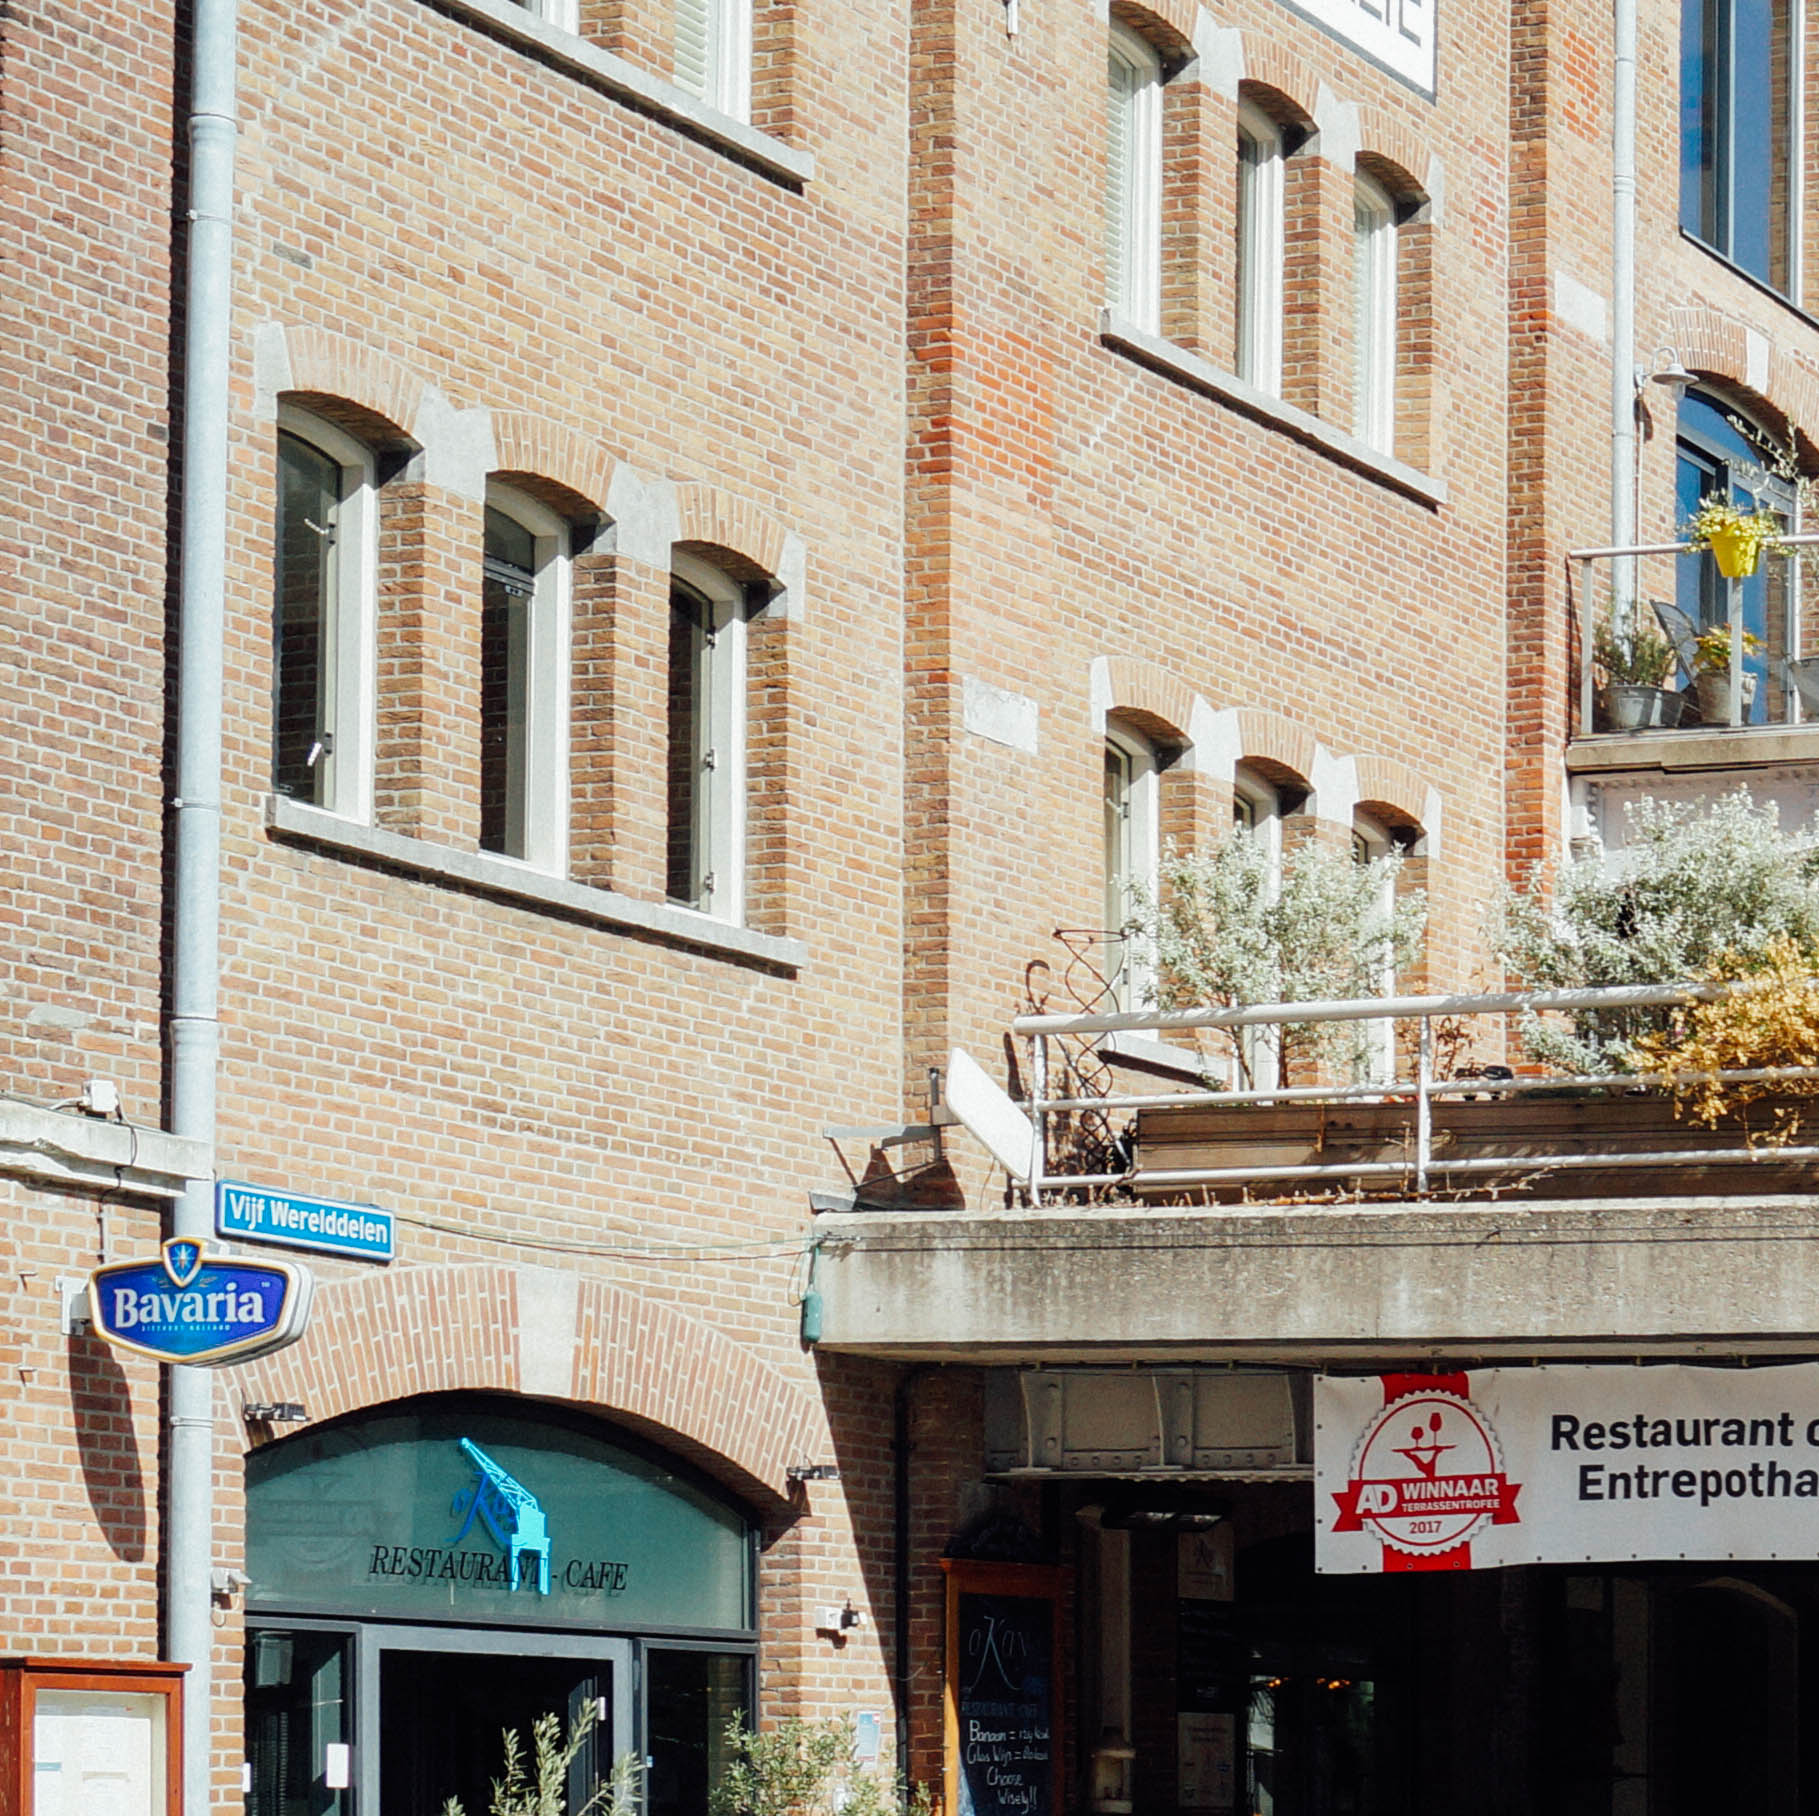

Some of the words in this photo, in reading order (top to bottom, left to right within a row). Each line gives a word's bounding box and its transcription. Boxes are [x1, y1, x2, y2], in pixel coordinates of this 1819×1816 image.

[229, 1192, 265, 1231] Vijf
[270, 1199, 388, 1244] Werelddelen
[113, 1281, 265, 1329] Bavaria
[1551, 1412, 1794, 1451] Restaurant
[1355, 1484, 1398, 1514] AD
[1402, 1478, 1499, 1500] WINNAAR
[1402, 1499, 1500, 1513] TERRASSENTROFEE
[1409, 1521, 1442, 1534] 2017
[370, 1545, 541, 1586] RESTAURANT
[566, 1559, 629, 1591] CAFE
[986, 1765, 1024, 1786] Choose
